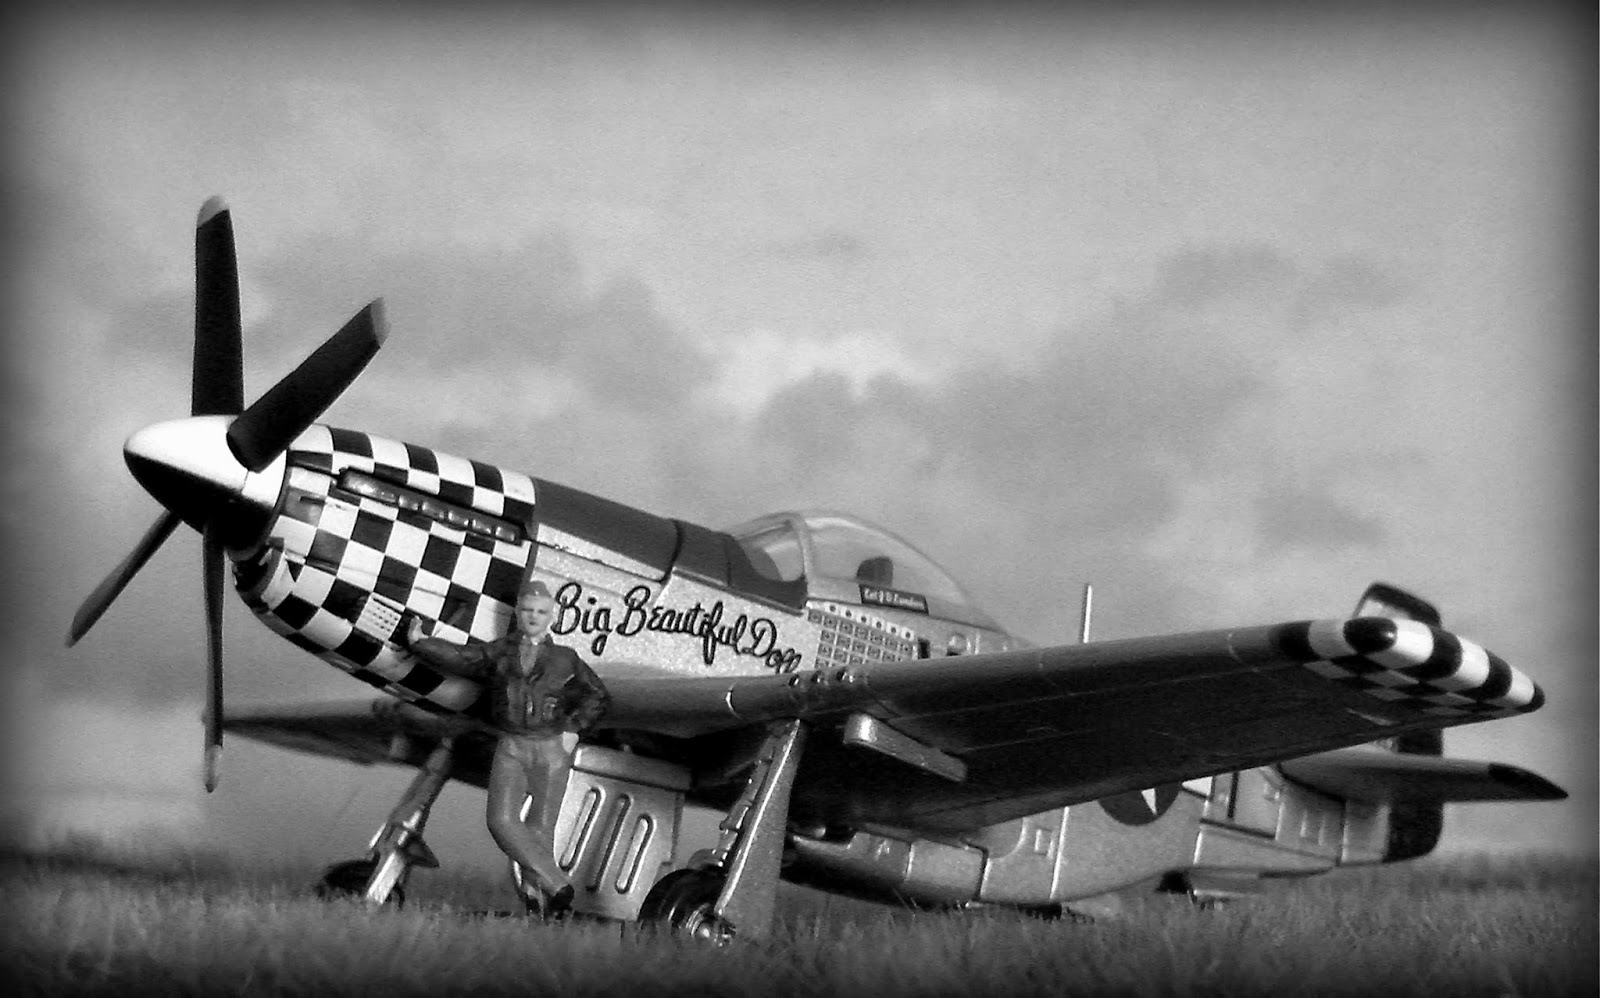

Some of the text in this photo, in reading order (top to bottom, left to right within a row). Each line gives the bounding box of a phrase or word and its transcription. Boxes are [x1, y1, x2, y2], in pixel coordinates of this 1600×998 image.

[550, 581, 802, 674] Big Beautiful Doll
